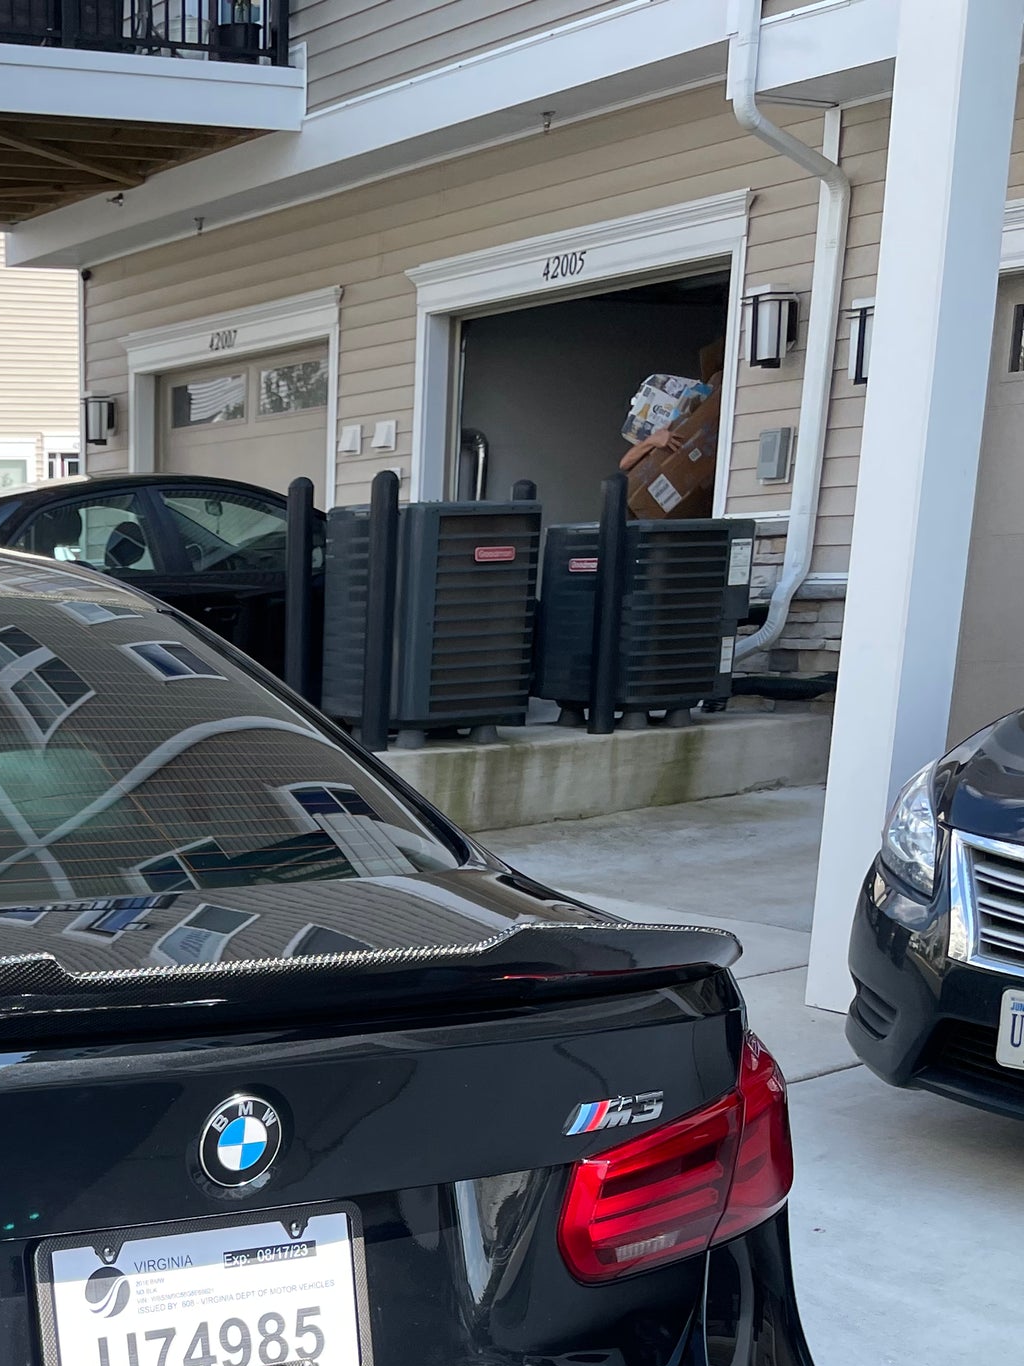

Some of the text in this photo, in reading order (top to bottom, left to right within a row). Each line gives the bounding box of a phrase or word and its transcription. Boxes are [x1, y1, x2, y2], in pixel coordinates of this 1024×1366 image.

[542, 251, 587, 281] 42005
[212, 1101, 277, 1132] BMW
[134, 1254, 194, 1274] VIRGINIA
[223, 1244, 309, 1268] Exp: 08/17/23
[137, 1303, 166, 1314] ISSUED
[200, 1294, 234, 1305] VIRGINIA
[235, 1290, 255, 1301] DEPT
[257, 1288, 268, 1297] OF
[269, 1285, 297, 1295] MOTOR
[298, 1279, 335, 1291] VEHICLES
